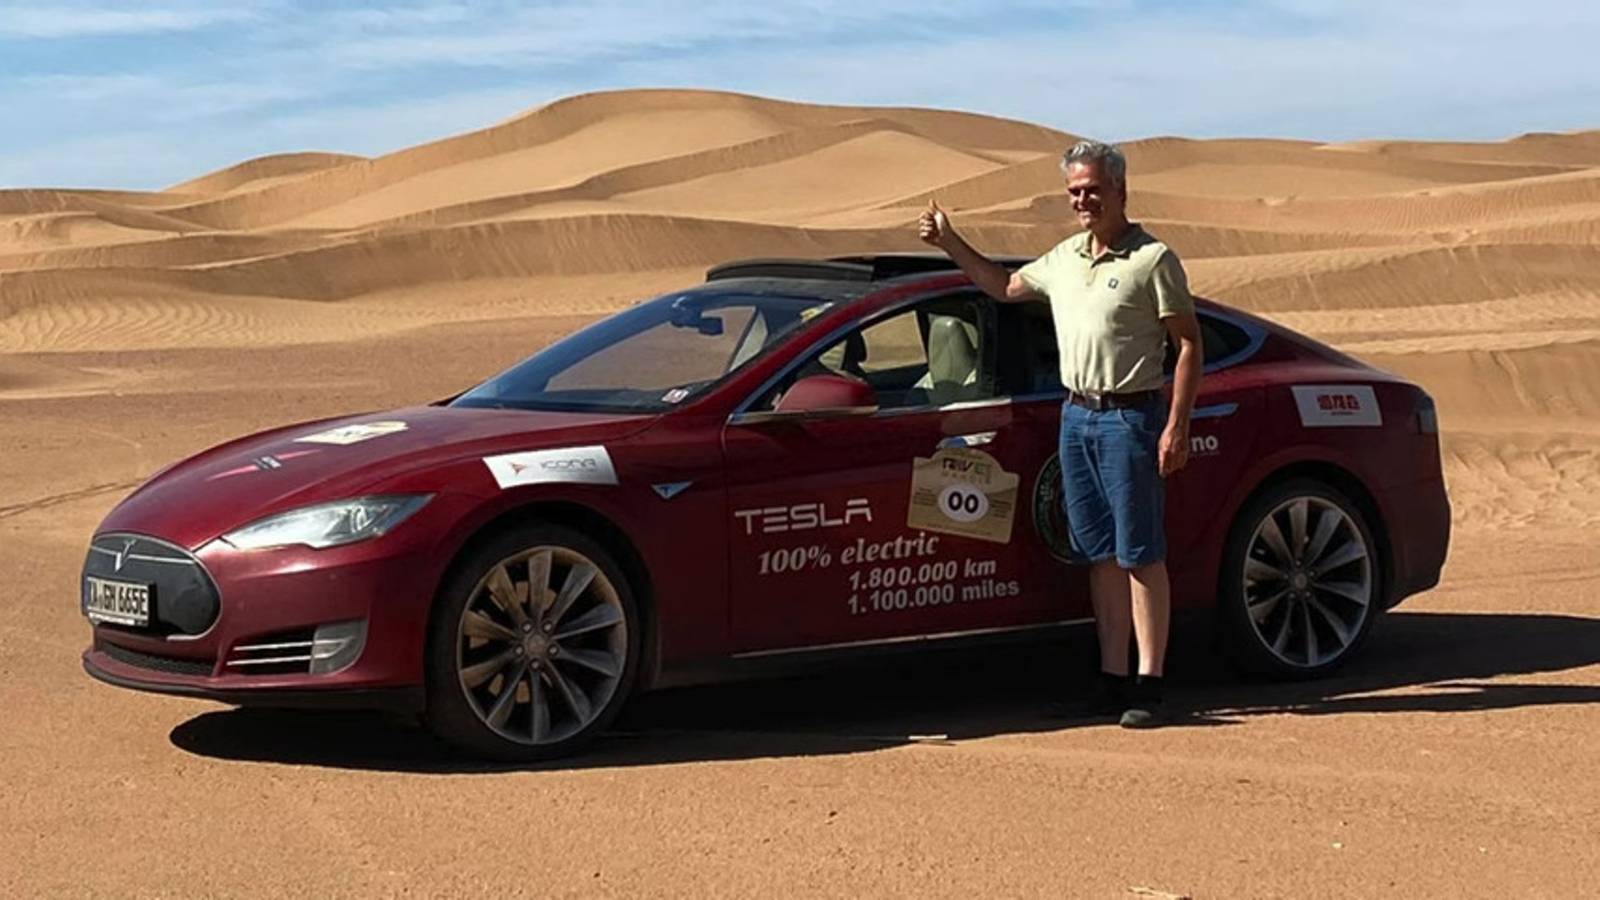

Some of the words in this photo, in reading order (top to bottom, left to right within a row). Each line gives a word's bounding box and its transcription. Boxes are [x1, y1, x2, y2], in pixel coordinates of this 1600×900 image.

[1190, 434, 1219, 453] no
[734, 497, 873, 535] TESLA
[948, 491, 979, 514] 00
[757, 545, 833, 575] 100%
[840, 531, 941, 566] electric
[848, 561, 958, 591] 1.800.000
[963, 558, 997, 578] km
[118, 586, 148, 616] 665E
[847, 583, 955, 615] 1.100.000
[961, 579, 1020, 603] miles
